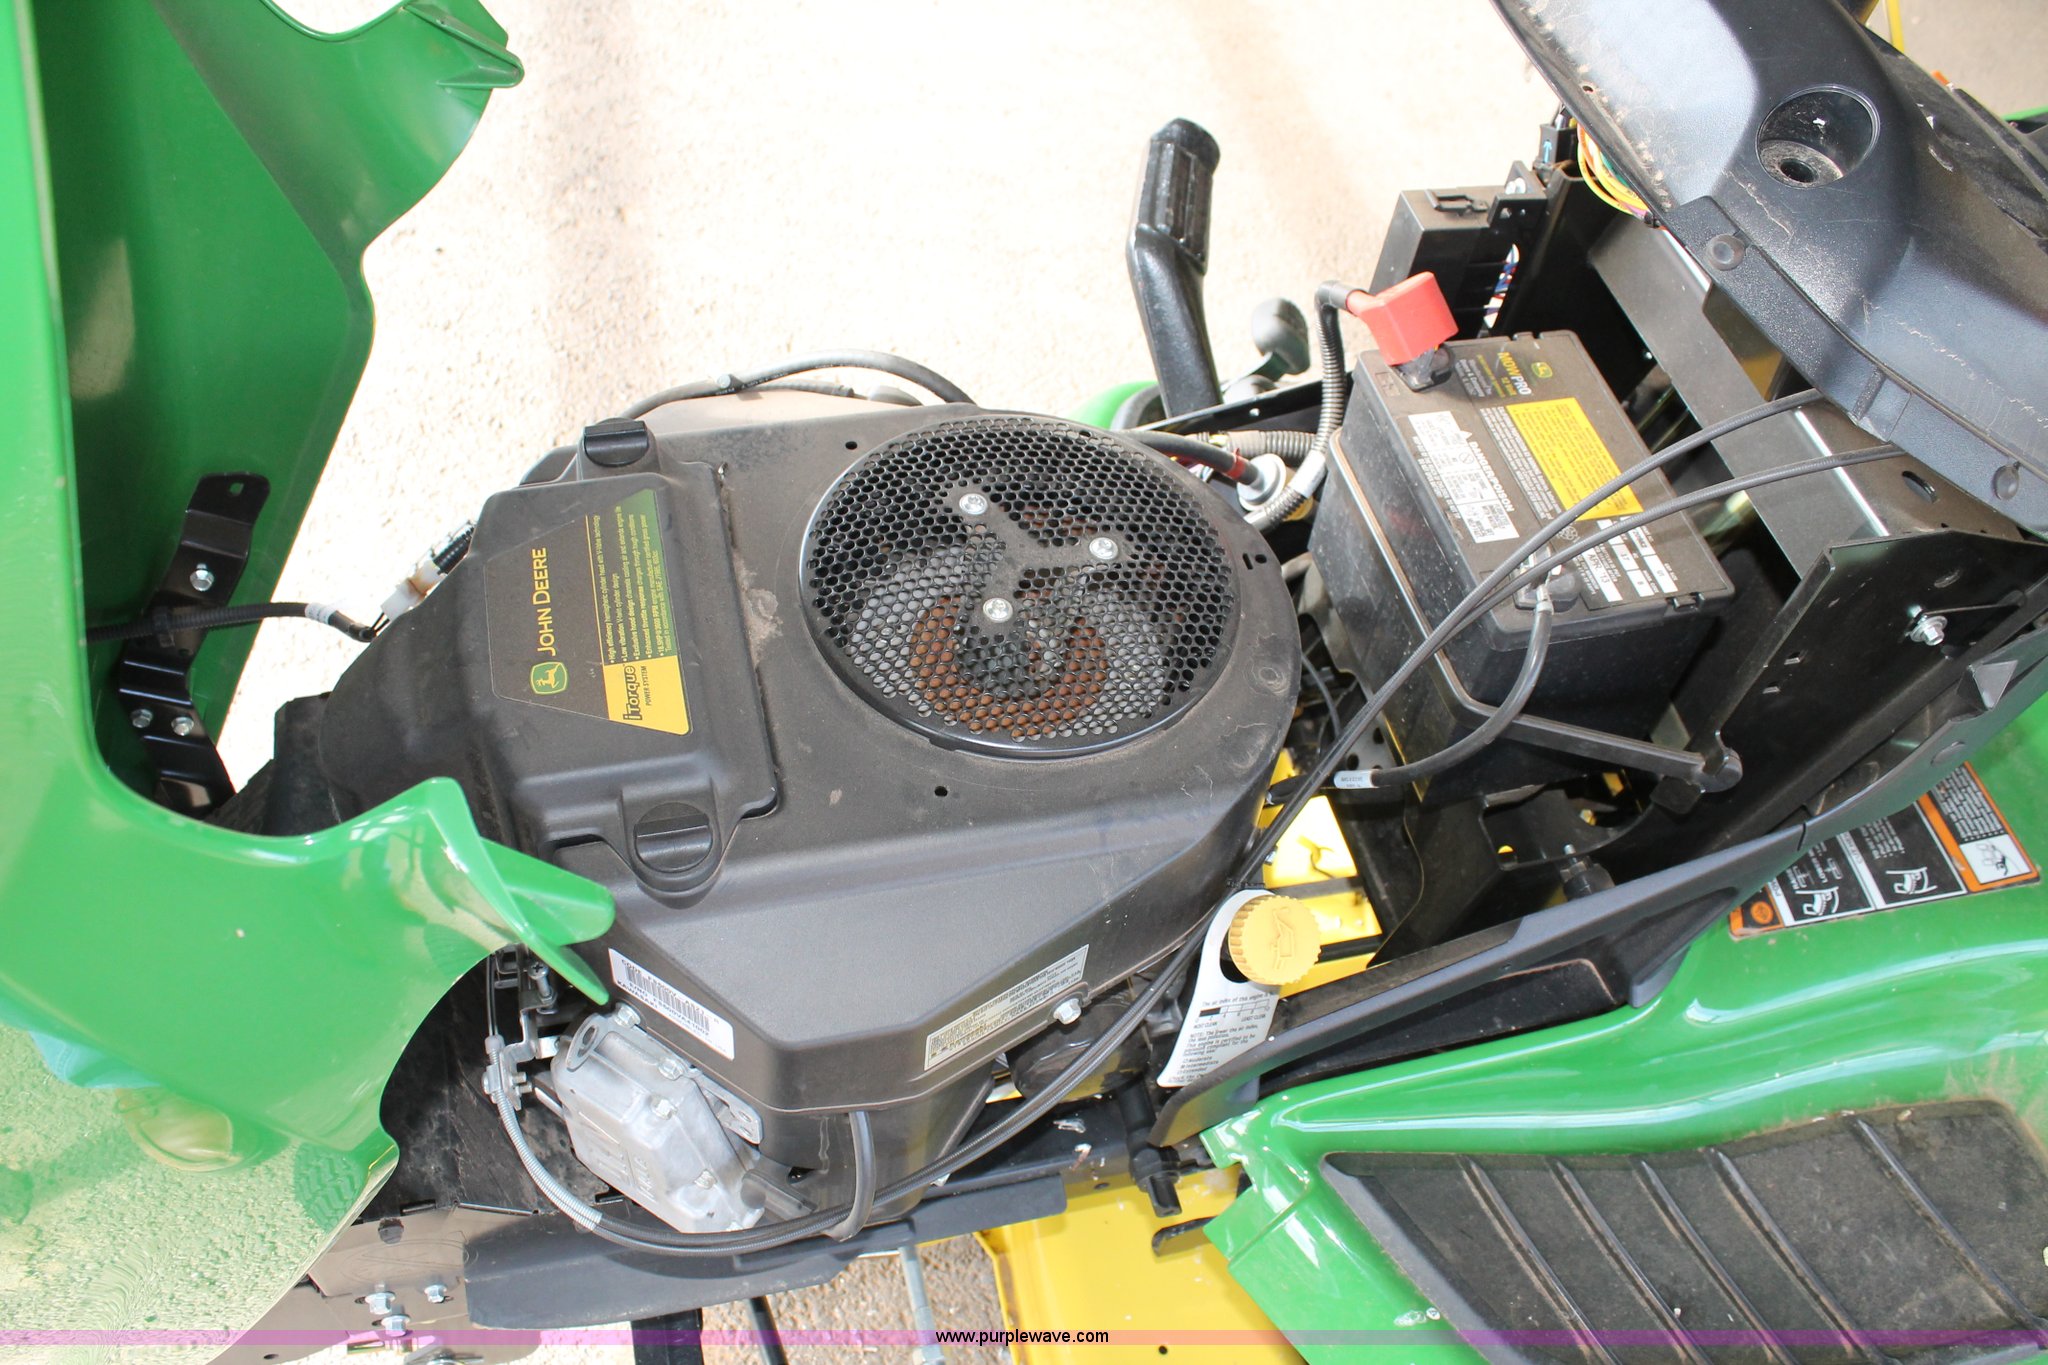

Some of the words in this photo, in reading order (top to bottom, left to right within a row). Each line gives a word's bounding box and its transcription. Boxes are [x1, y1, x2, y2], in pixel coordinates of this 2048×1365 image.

[1496, 351, 1533, 395] MOWPRO
[531, 547, 551, 605] DEERE
[536, 607, 556, 656] JOHN
[617, 979, 657, 1009] KAWASAKI
